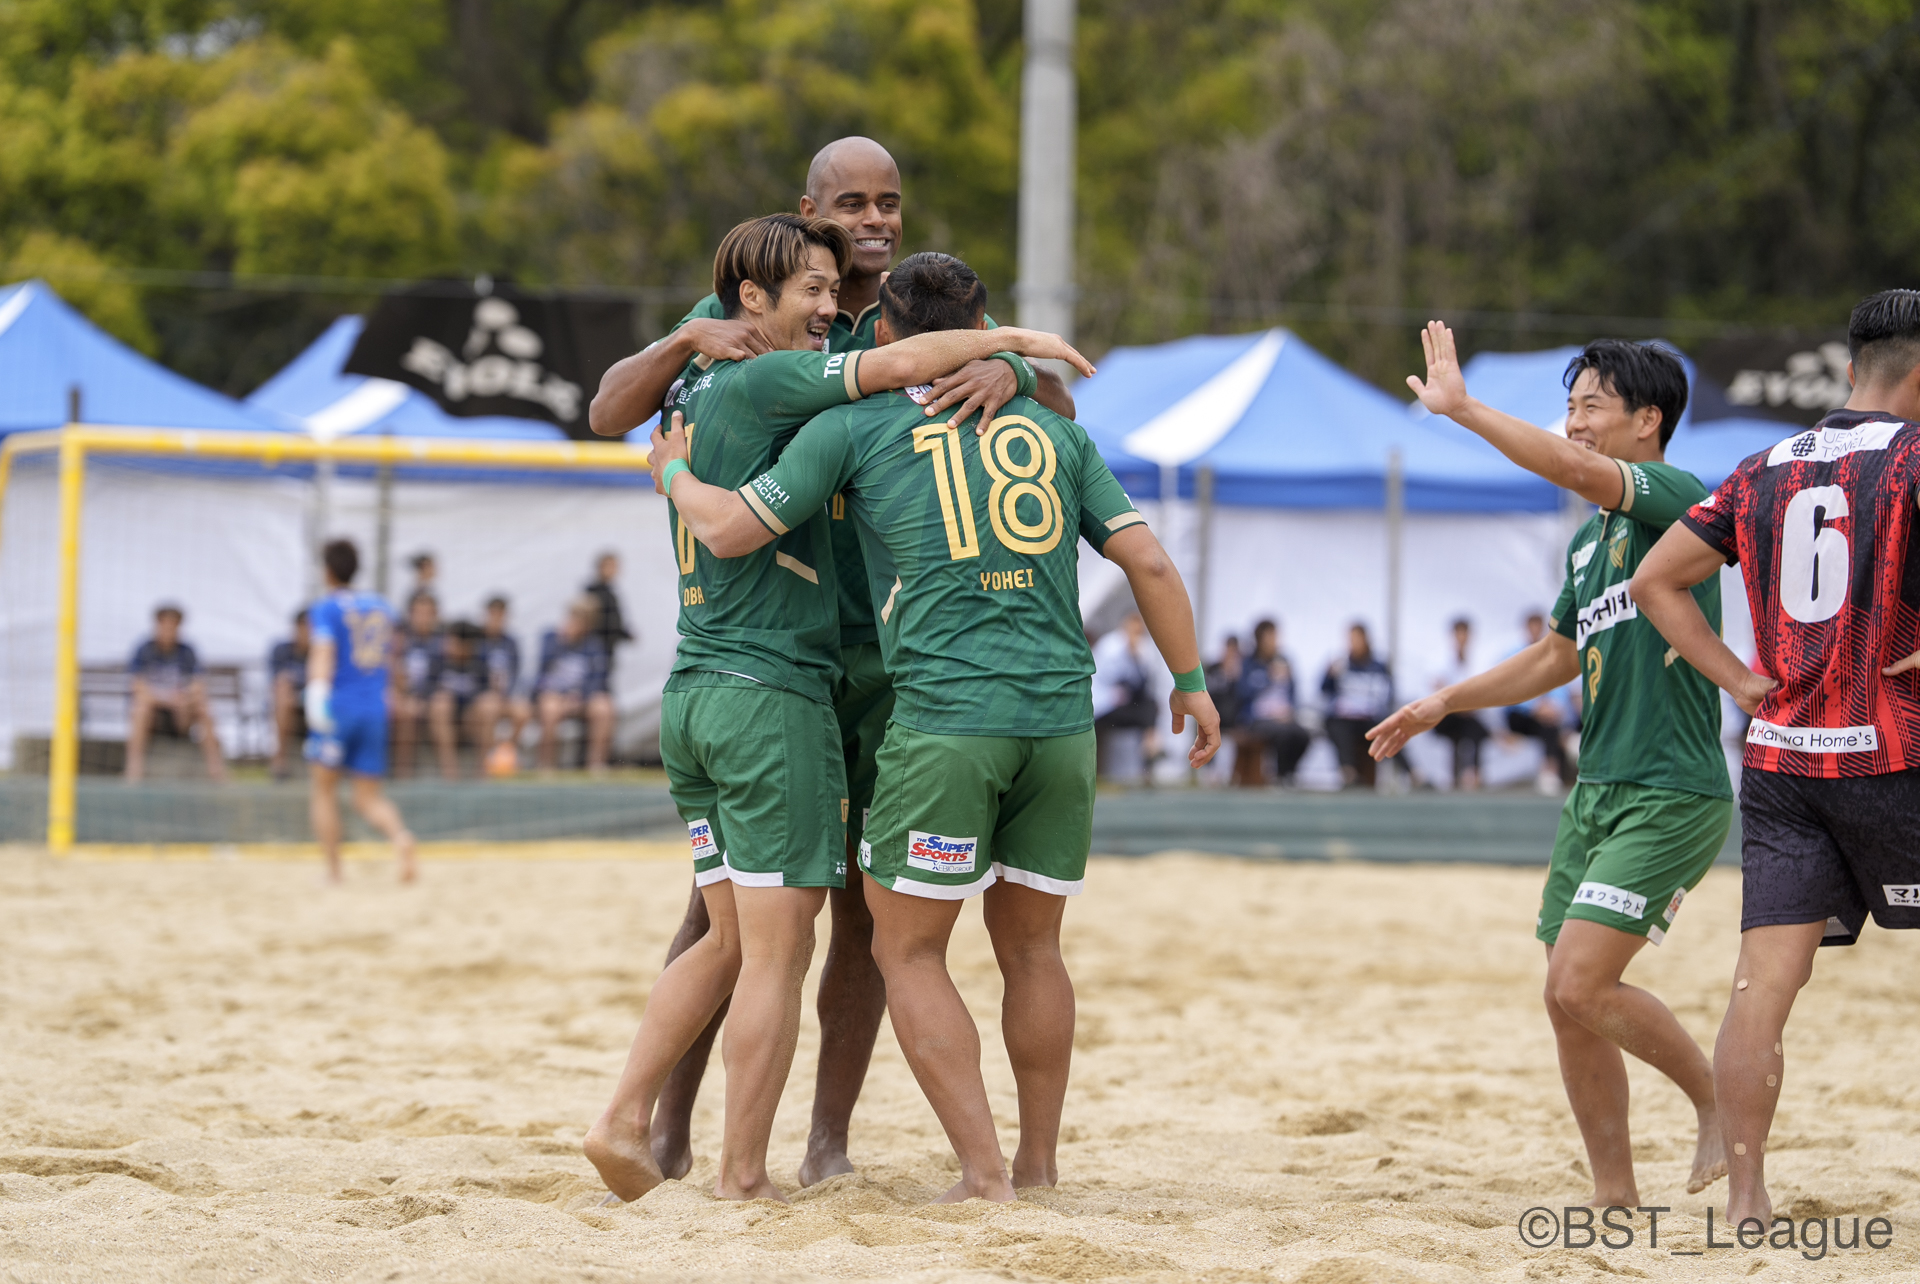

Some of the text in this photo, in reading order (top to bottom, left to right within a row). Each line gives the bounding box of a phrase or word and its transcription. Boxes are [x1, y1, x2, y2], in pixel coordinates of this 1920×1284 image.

[911, 414, 1064, 561] 18
[1780, 483, 1850, 623] 6
[979, 568, 1035, 592] YOHEI
[683, 586, 705, 607] OBA
[1587, 646, 1603, 704] 2
[1810, 731, 1873, 748] Home's
[910, 842, 969, 862] SPORTS
[926, 835, 975, 853] SUPER
